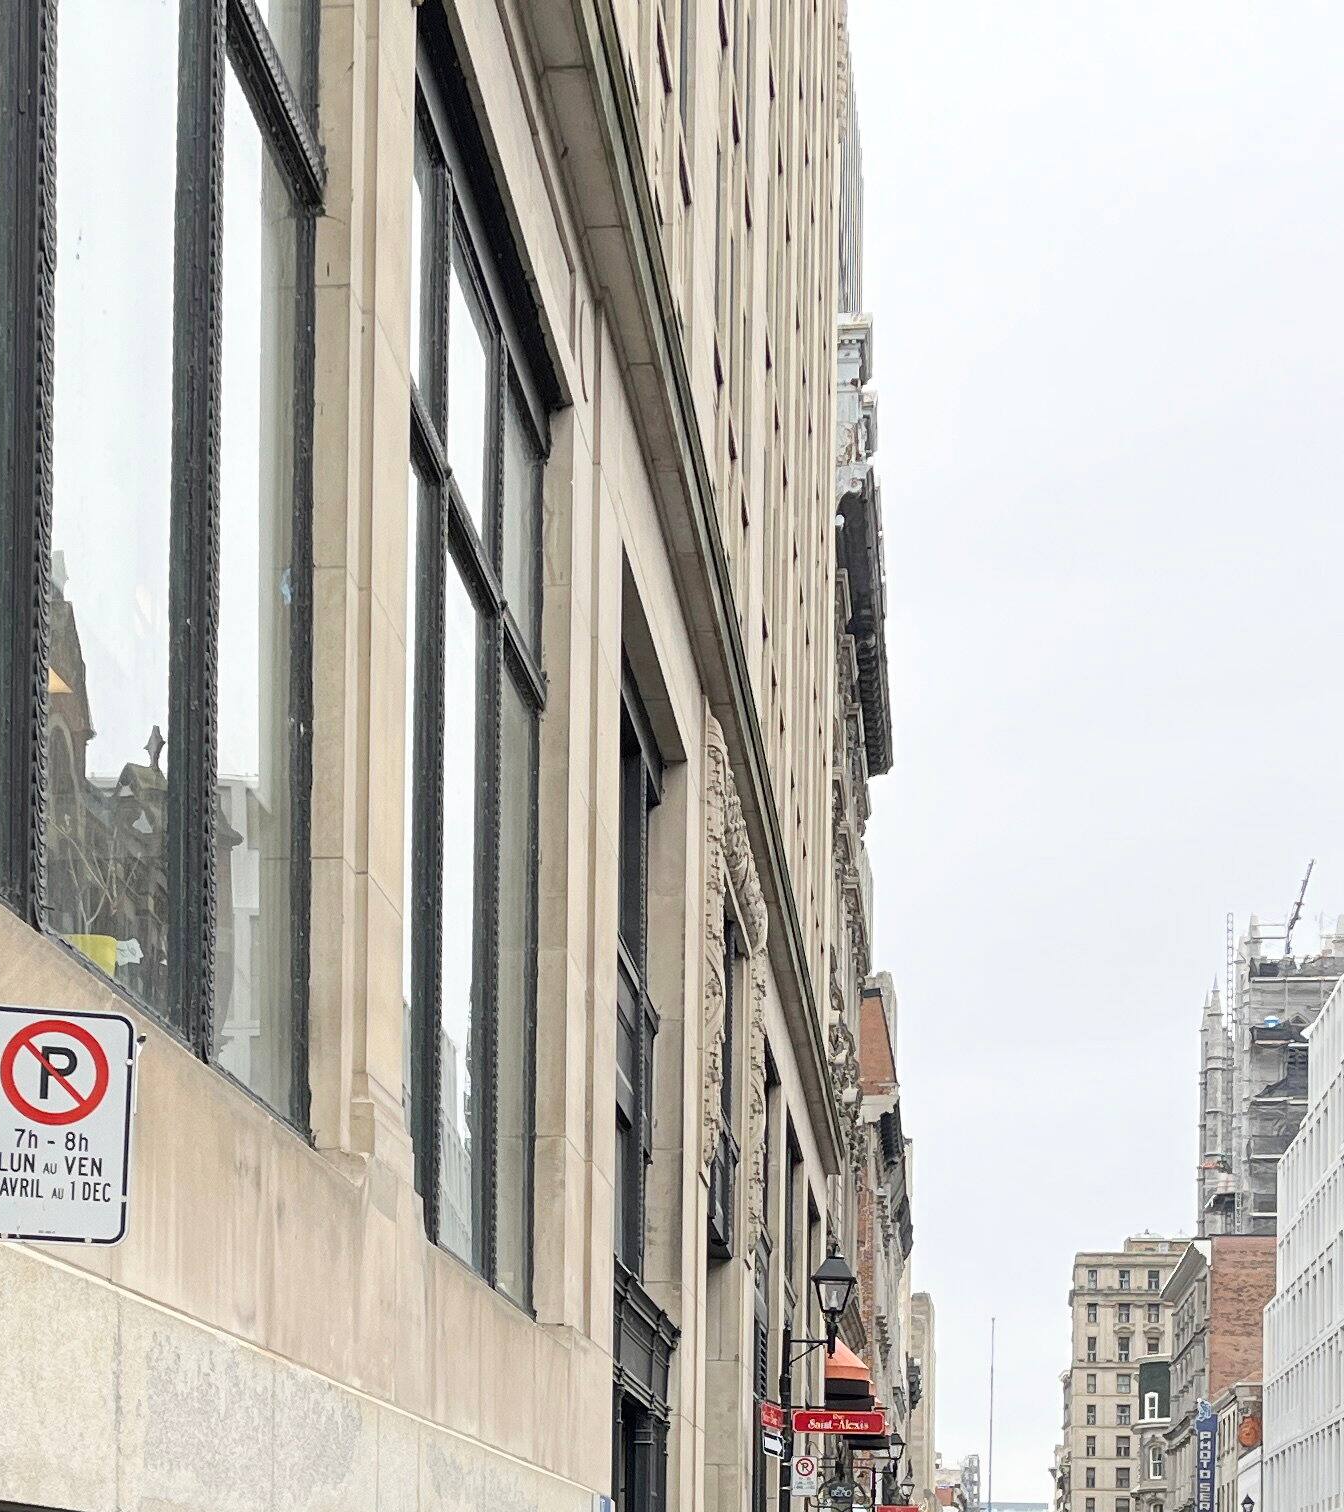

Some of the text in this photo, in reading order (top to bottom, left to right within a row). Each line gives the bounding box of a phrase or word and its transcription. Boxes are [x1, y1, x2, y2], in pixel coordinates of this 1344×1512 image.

[14, 1128, 38, 1149] 7h
[64, 1131, 89, 1152] 8h
[42, 1163, 57, 1175] AU
[64, 1155, 103, 1177] VEN
[0, 1176, 43, 1199] AVRIL
[51, 1188, 64, 1200] AU
[70, 1180, 75, 1201] 1
[81, 1181, 111, 1202] DEC
[1199, 1431, 1211, 1479] PHOTO
